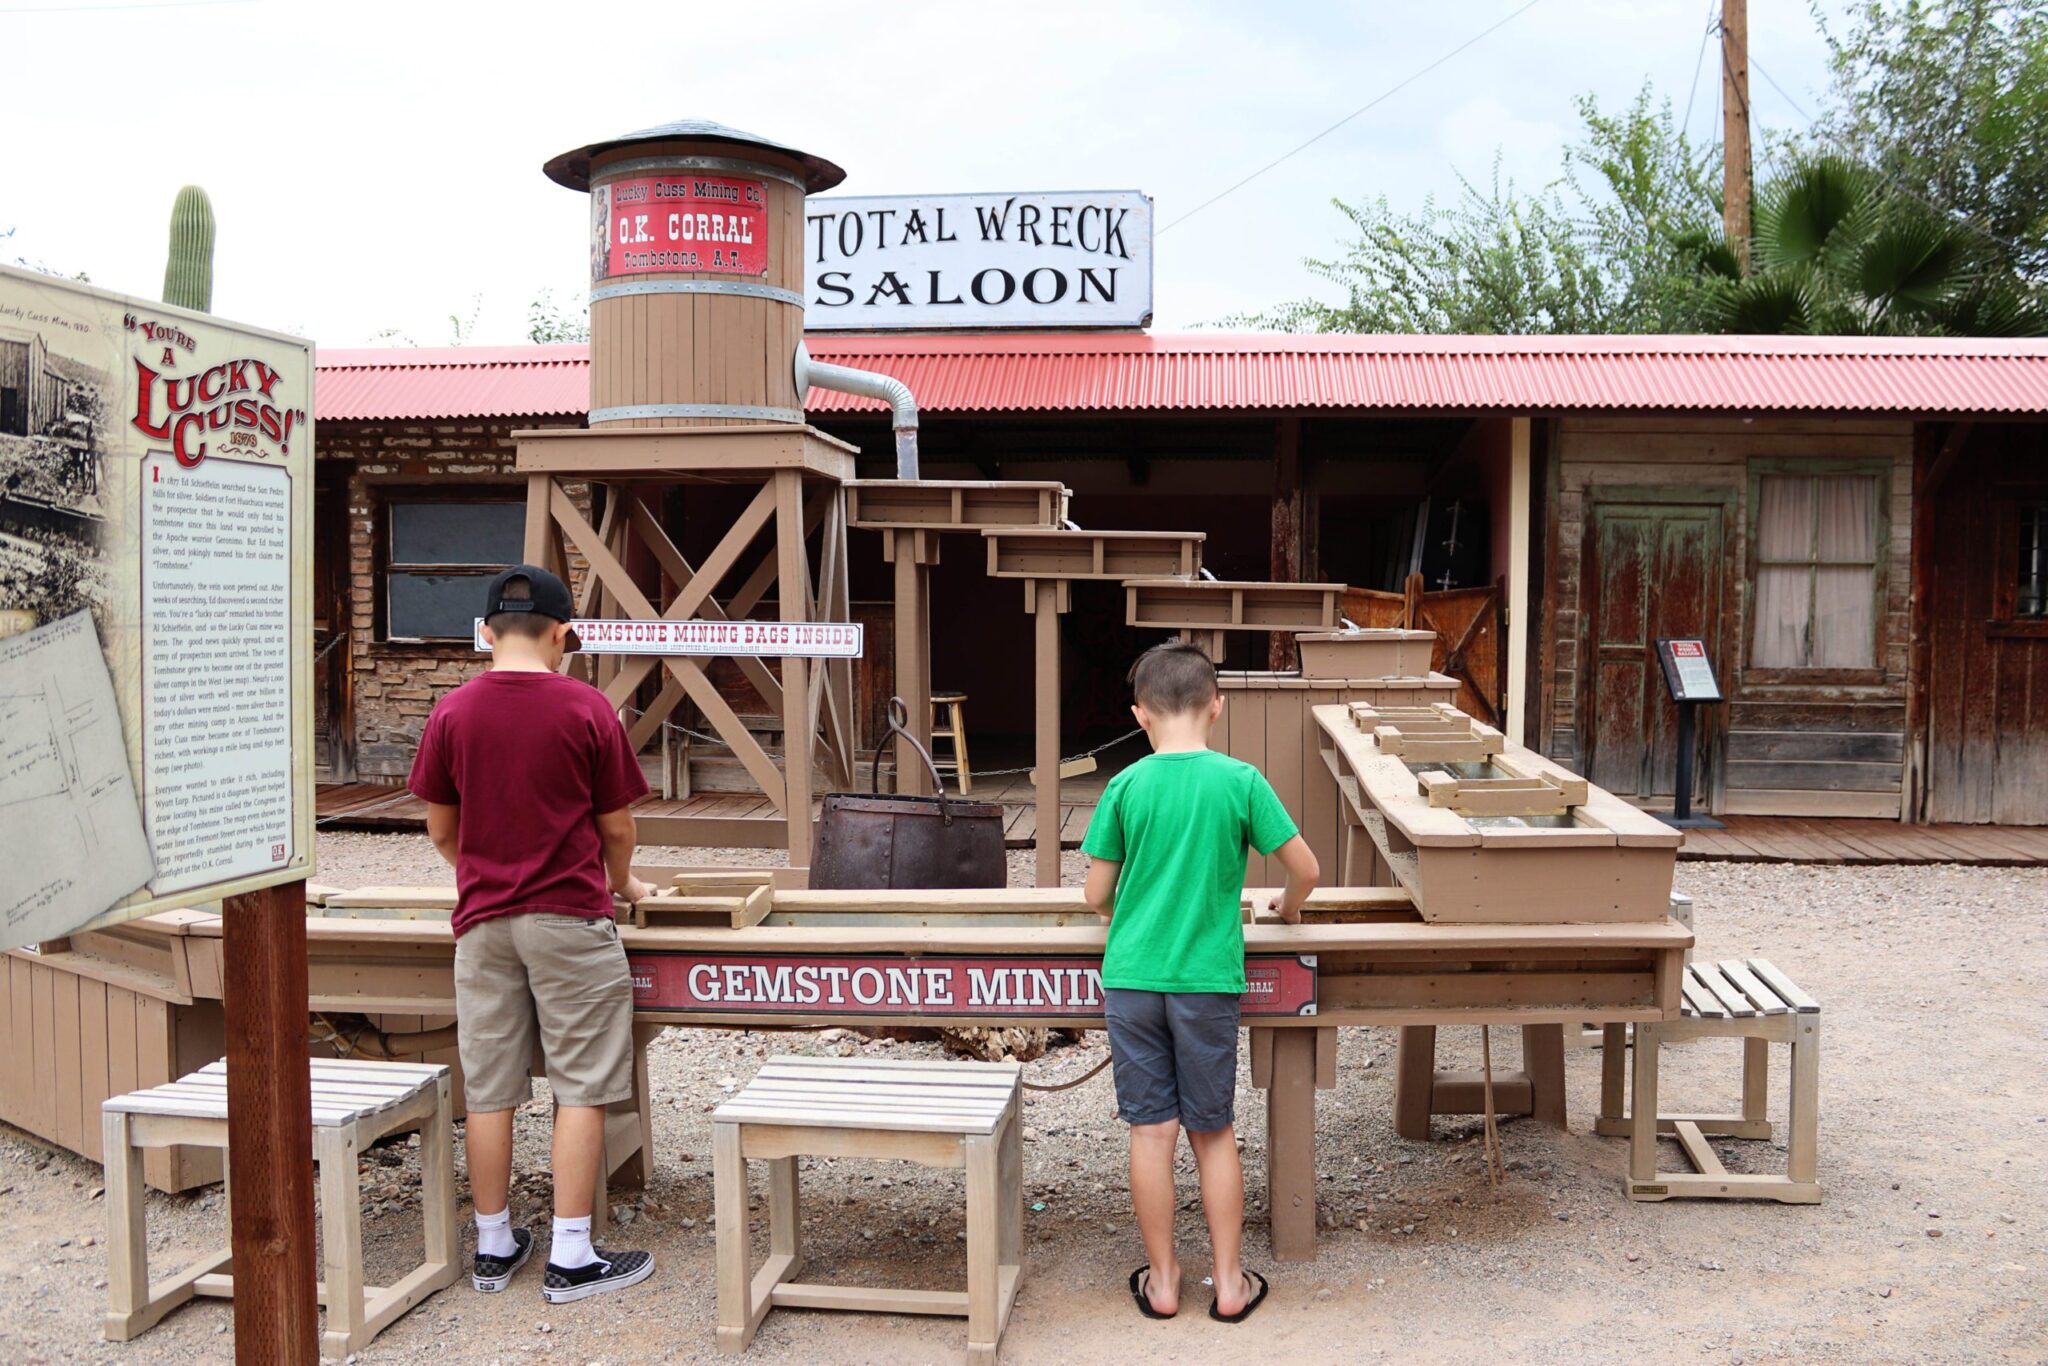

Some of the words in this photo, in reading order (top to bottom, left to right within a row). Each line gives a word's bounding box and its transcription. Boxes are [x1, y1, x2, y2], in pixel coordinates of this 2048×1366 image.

[615, 184, 648, 203] Lucky
[655, 182, 686, 197] Cuss
[693, 182, 739, 203] Mining
[746, 188, 764, 203] Co.
[619, 215, 655, 245] O.K.
[668, 213, 752, 245] CORRAL
[807, 208, 958, 263] TOTAL
[975, 197, 1131, 260] WRECK
[624, 250, 703, 270] Tombstone,
[713, 250, 743, 269] A.T.
[814, 268, 1121, 307] SALOON
[160, 346, 176, 367] A
[131, 356, 283, 441] LUCKY
[229, 431, 258, 448] 1878
[153, 503, 162, 512] the
[167, 507, 197, 515] prospector
[201, 507, 212, 516] that
[228, 510, 244, 518] would
[188, 520, 202, 528] since
[153, 532, 162, 540] the
[167, 532, 188, 543] Apache
[174, 547, 185, 555] and
[188, 548, 210, 559] jokingly
[198, 582, 207, 590] the
[195, 623, 206, 631] and
[218, 623, 226, 631] the
[229, 622, 244, 633] Lucky
[577, 624, 667, 642] GEMSTONE
[674, 625, 738, 643] MINING
[745, 626, 789, 644] BAGS
[795, 627, 854, 645] INSIDE
[172, 637, 182, 645] The
[188, 637, 202, 647] good
[222, 636, 240, 646] quickly
[153, 654, 169, 662] army
[188, 666, 202, 675] grew
[198, 678, 206, 686] the
[218, 689, 229, 698] well
[169, 721, 184, 730] other
[188, 719, 208, 729] mining
[211, 719, 226, 727] camp
[155, 736, 171, 746] Lucky
[155, 765, 169, 774] deep
[155, 785, 182, 794] Everyone
[167, 826, 181, 835] edge
[631, 977, 652, 988] RRAL
[687, 963, 953, 1006] GEMSTONE
[967, 967, 1104, 1006] MININ
[1246, 982, 1273, 993] ORRAL
